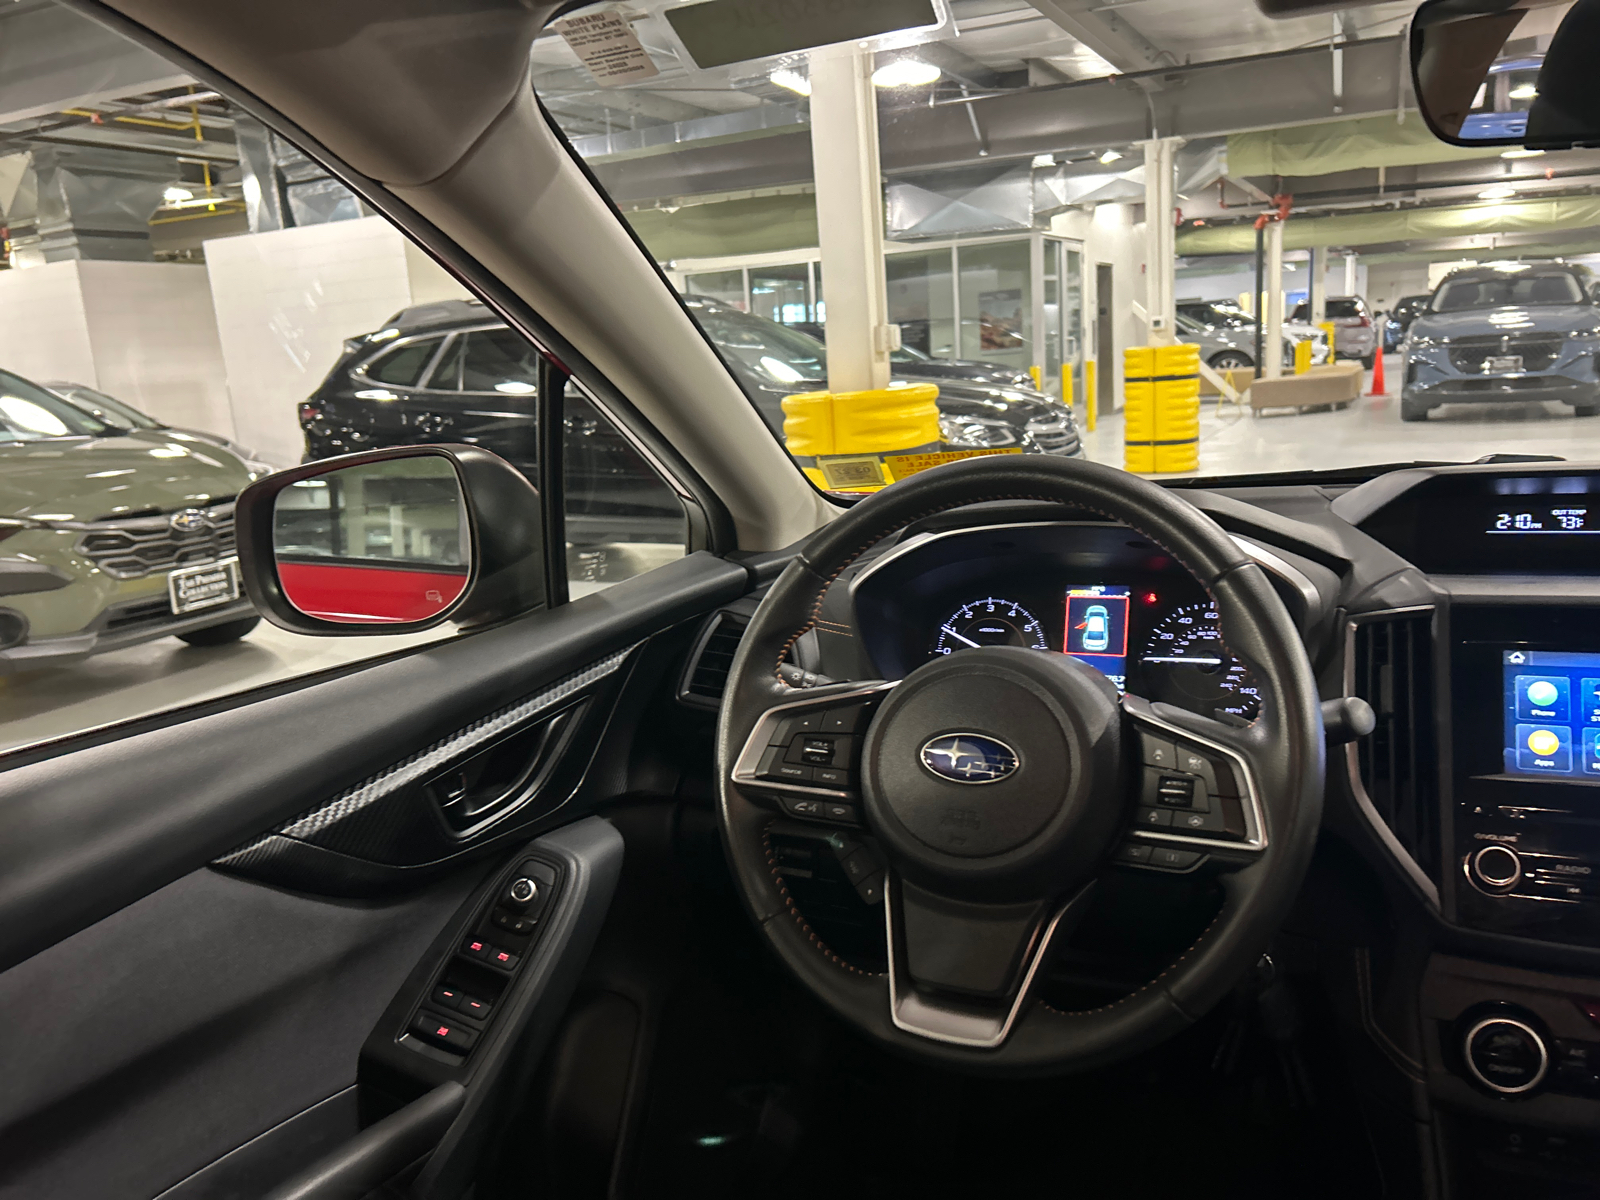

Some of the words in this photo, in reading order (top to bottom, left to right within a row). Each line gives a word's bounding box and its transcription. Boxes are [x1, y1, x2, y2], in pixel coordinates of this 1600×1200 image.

[565, 13, 605, 27] SUBARU
[562, 25, 591, 36] WHITE
[590, 19, 622, 31] PLAINS
[1496, 513, 1532, 529] 2:10
[986, 604, 995, 612] 3
[1007, 609, 1016, 617] 4
[1023, 624, 1033, 632] 5
[942, 647, 952, 655] 0
[1240, 687, 1257, 695] 140
[1556, 864, 1592, 875] RADIO
